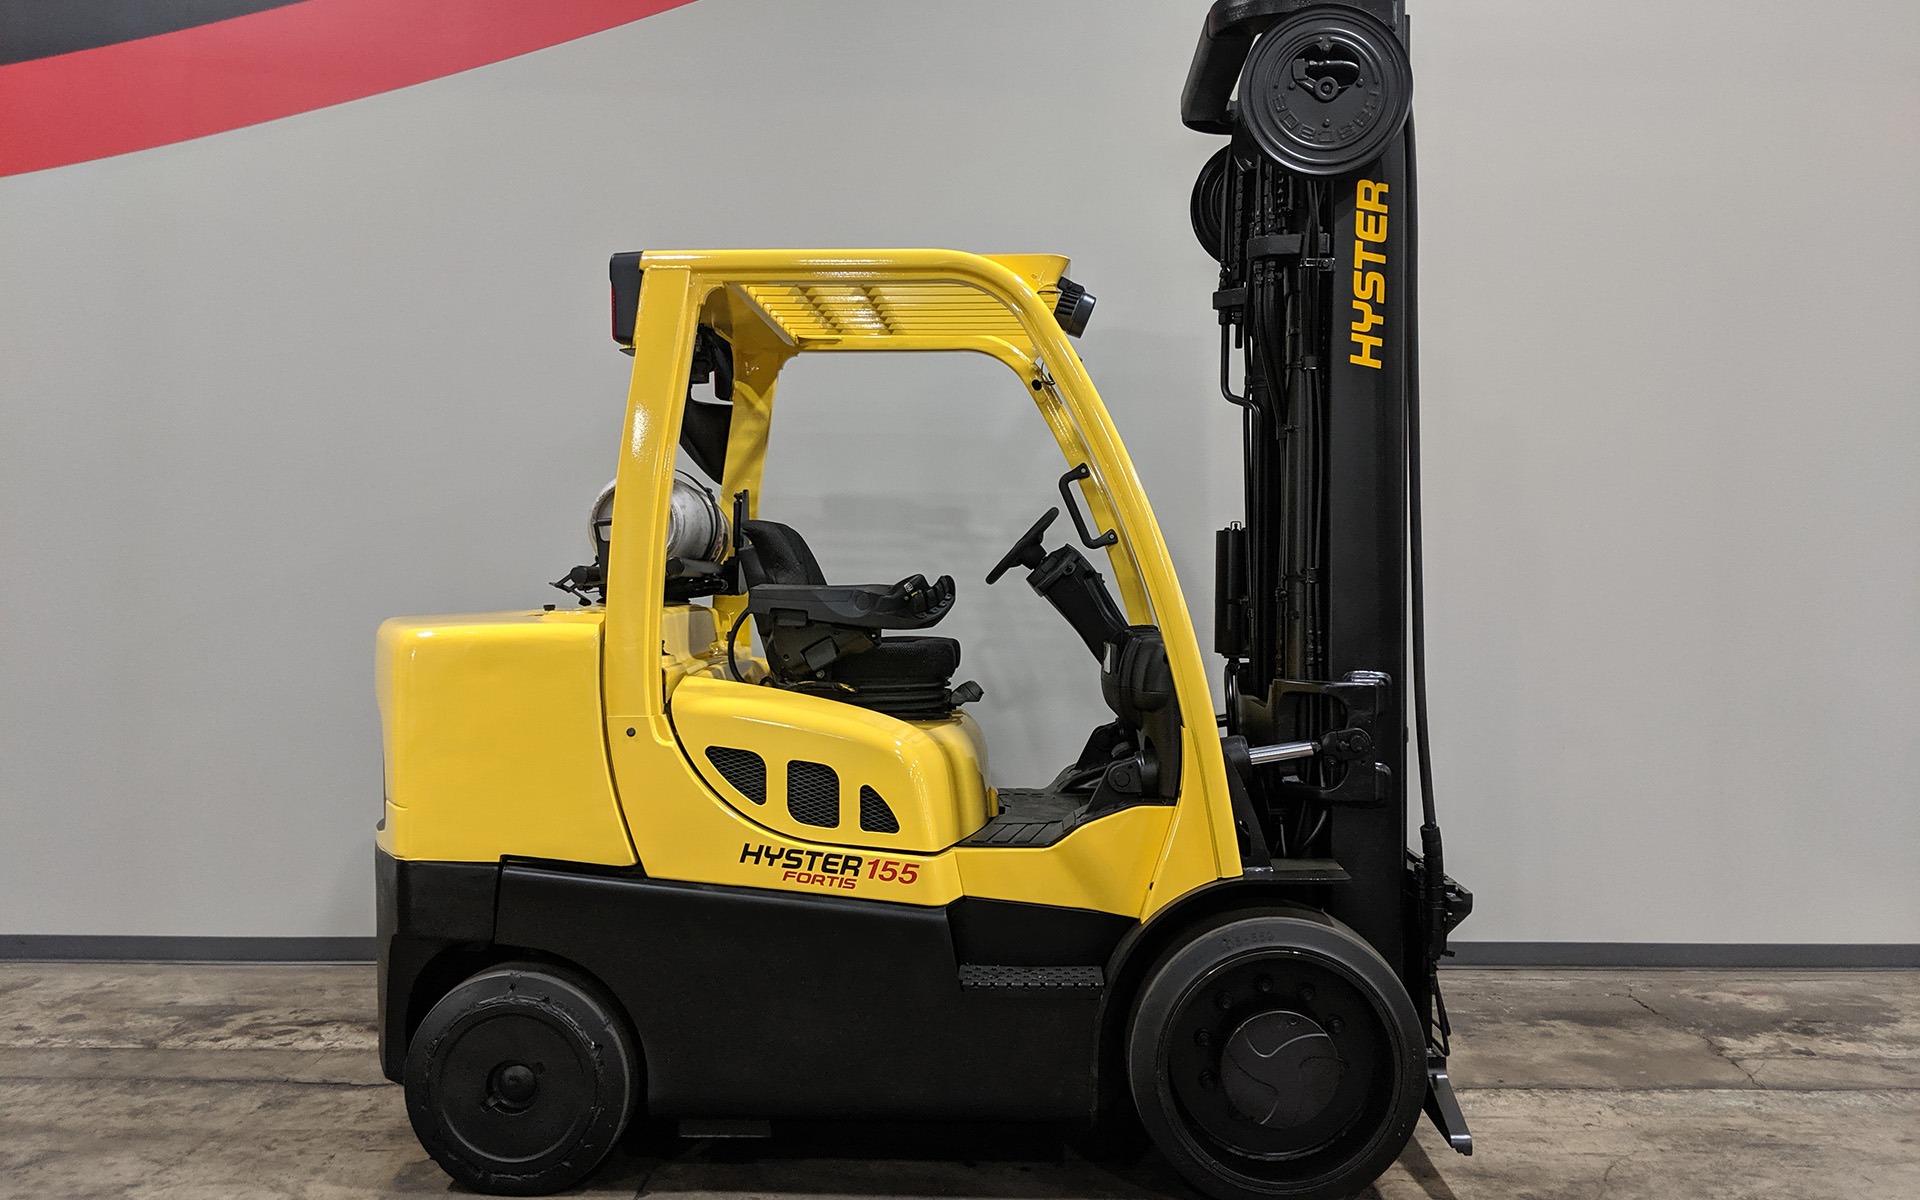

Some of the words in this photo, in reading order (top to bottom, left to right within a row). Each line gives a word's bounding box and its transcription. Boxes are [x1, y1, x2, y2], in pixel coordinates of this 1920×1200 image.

[1350, 179, 1389, 369] HYSTER
[739, 843, 863, 877] HYSTER
[867, 859, 920, 885] 155
[782, 871, 857, 889] FORTIS
